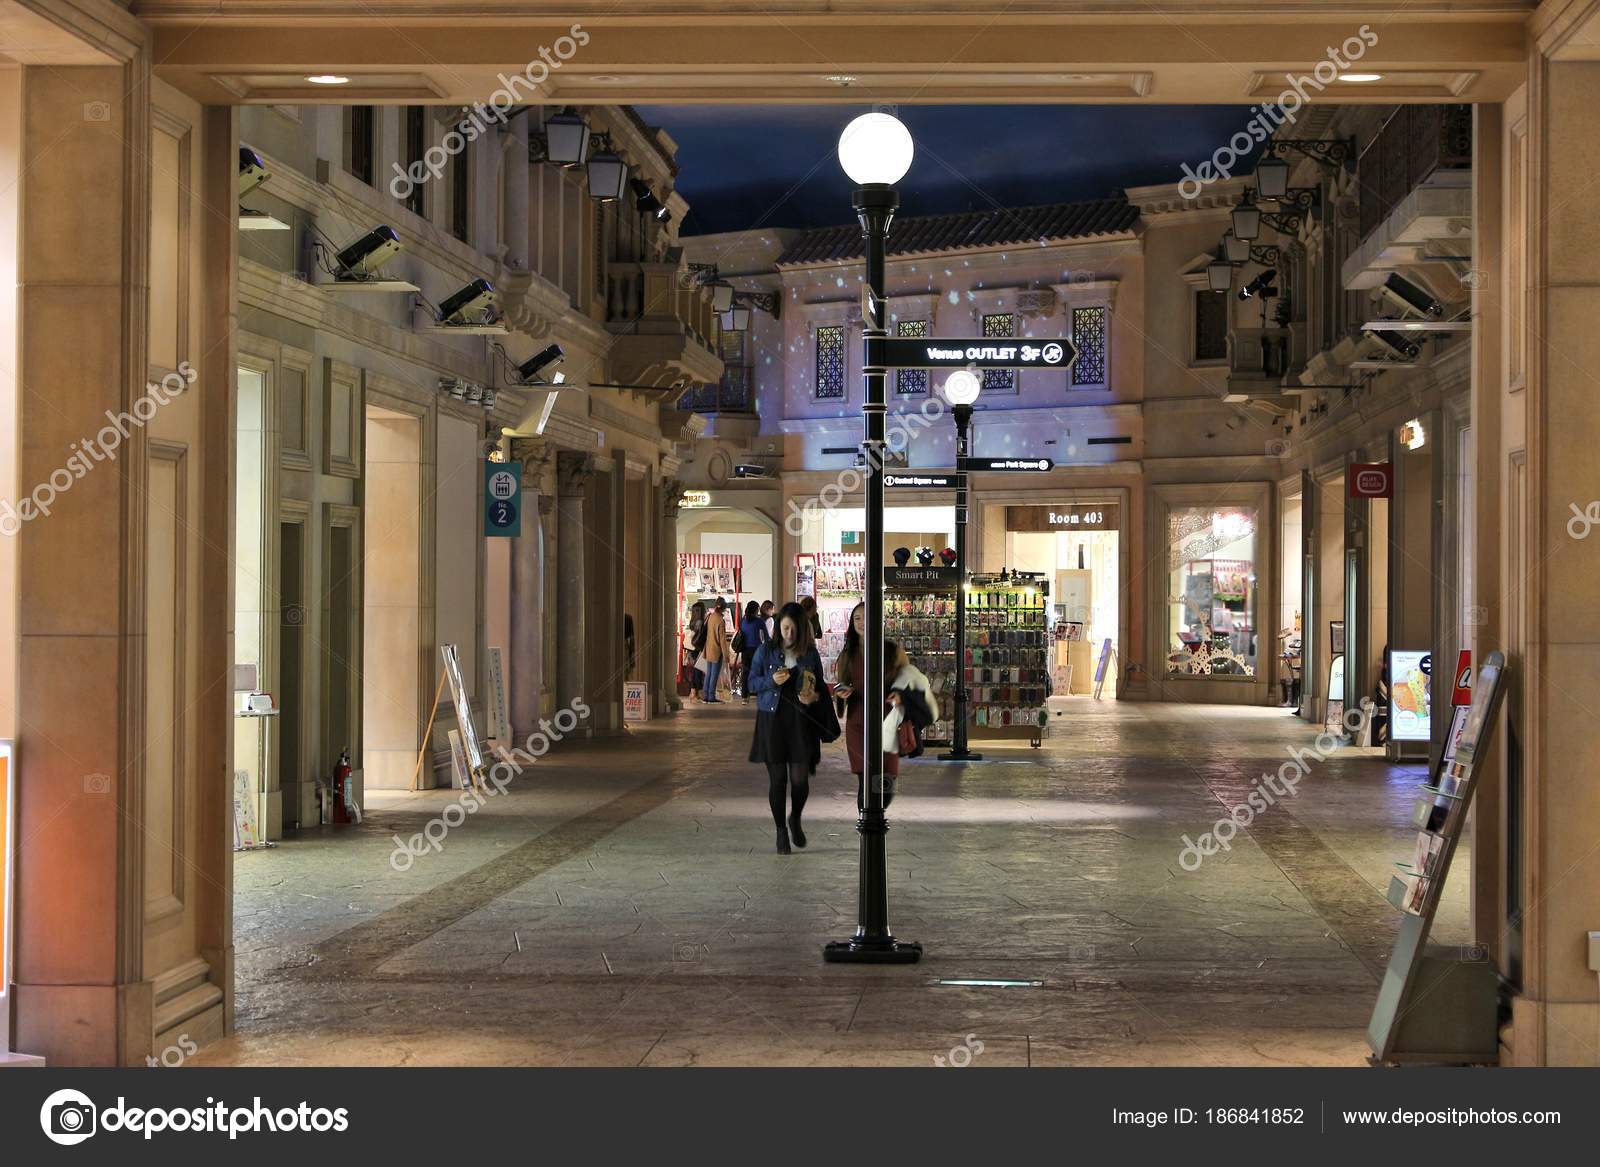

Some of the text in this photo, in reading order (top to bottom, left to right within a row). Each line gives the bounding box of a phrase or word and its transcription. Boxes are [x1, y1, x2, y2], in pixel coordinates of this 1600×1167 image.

[927, 345, 1041, 361] Venus OUTLET 3F
[498, 509, 507, 523] 2
[1049, 512, 1103, 524] Room 403
[896, 570, 939, 579] Smart Pit
[627, 690, 641, 698] TAX
